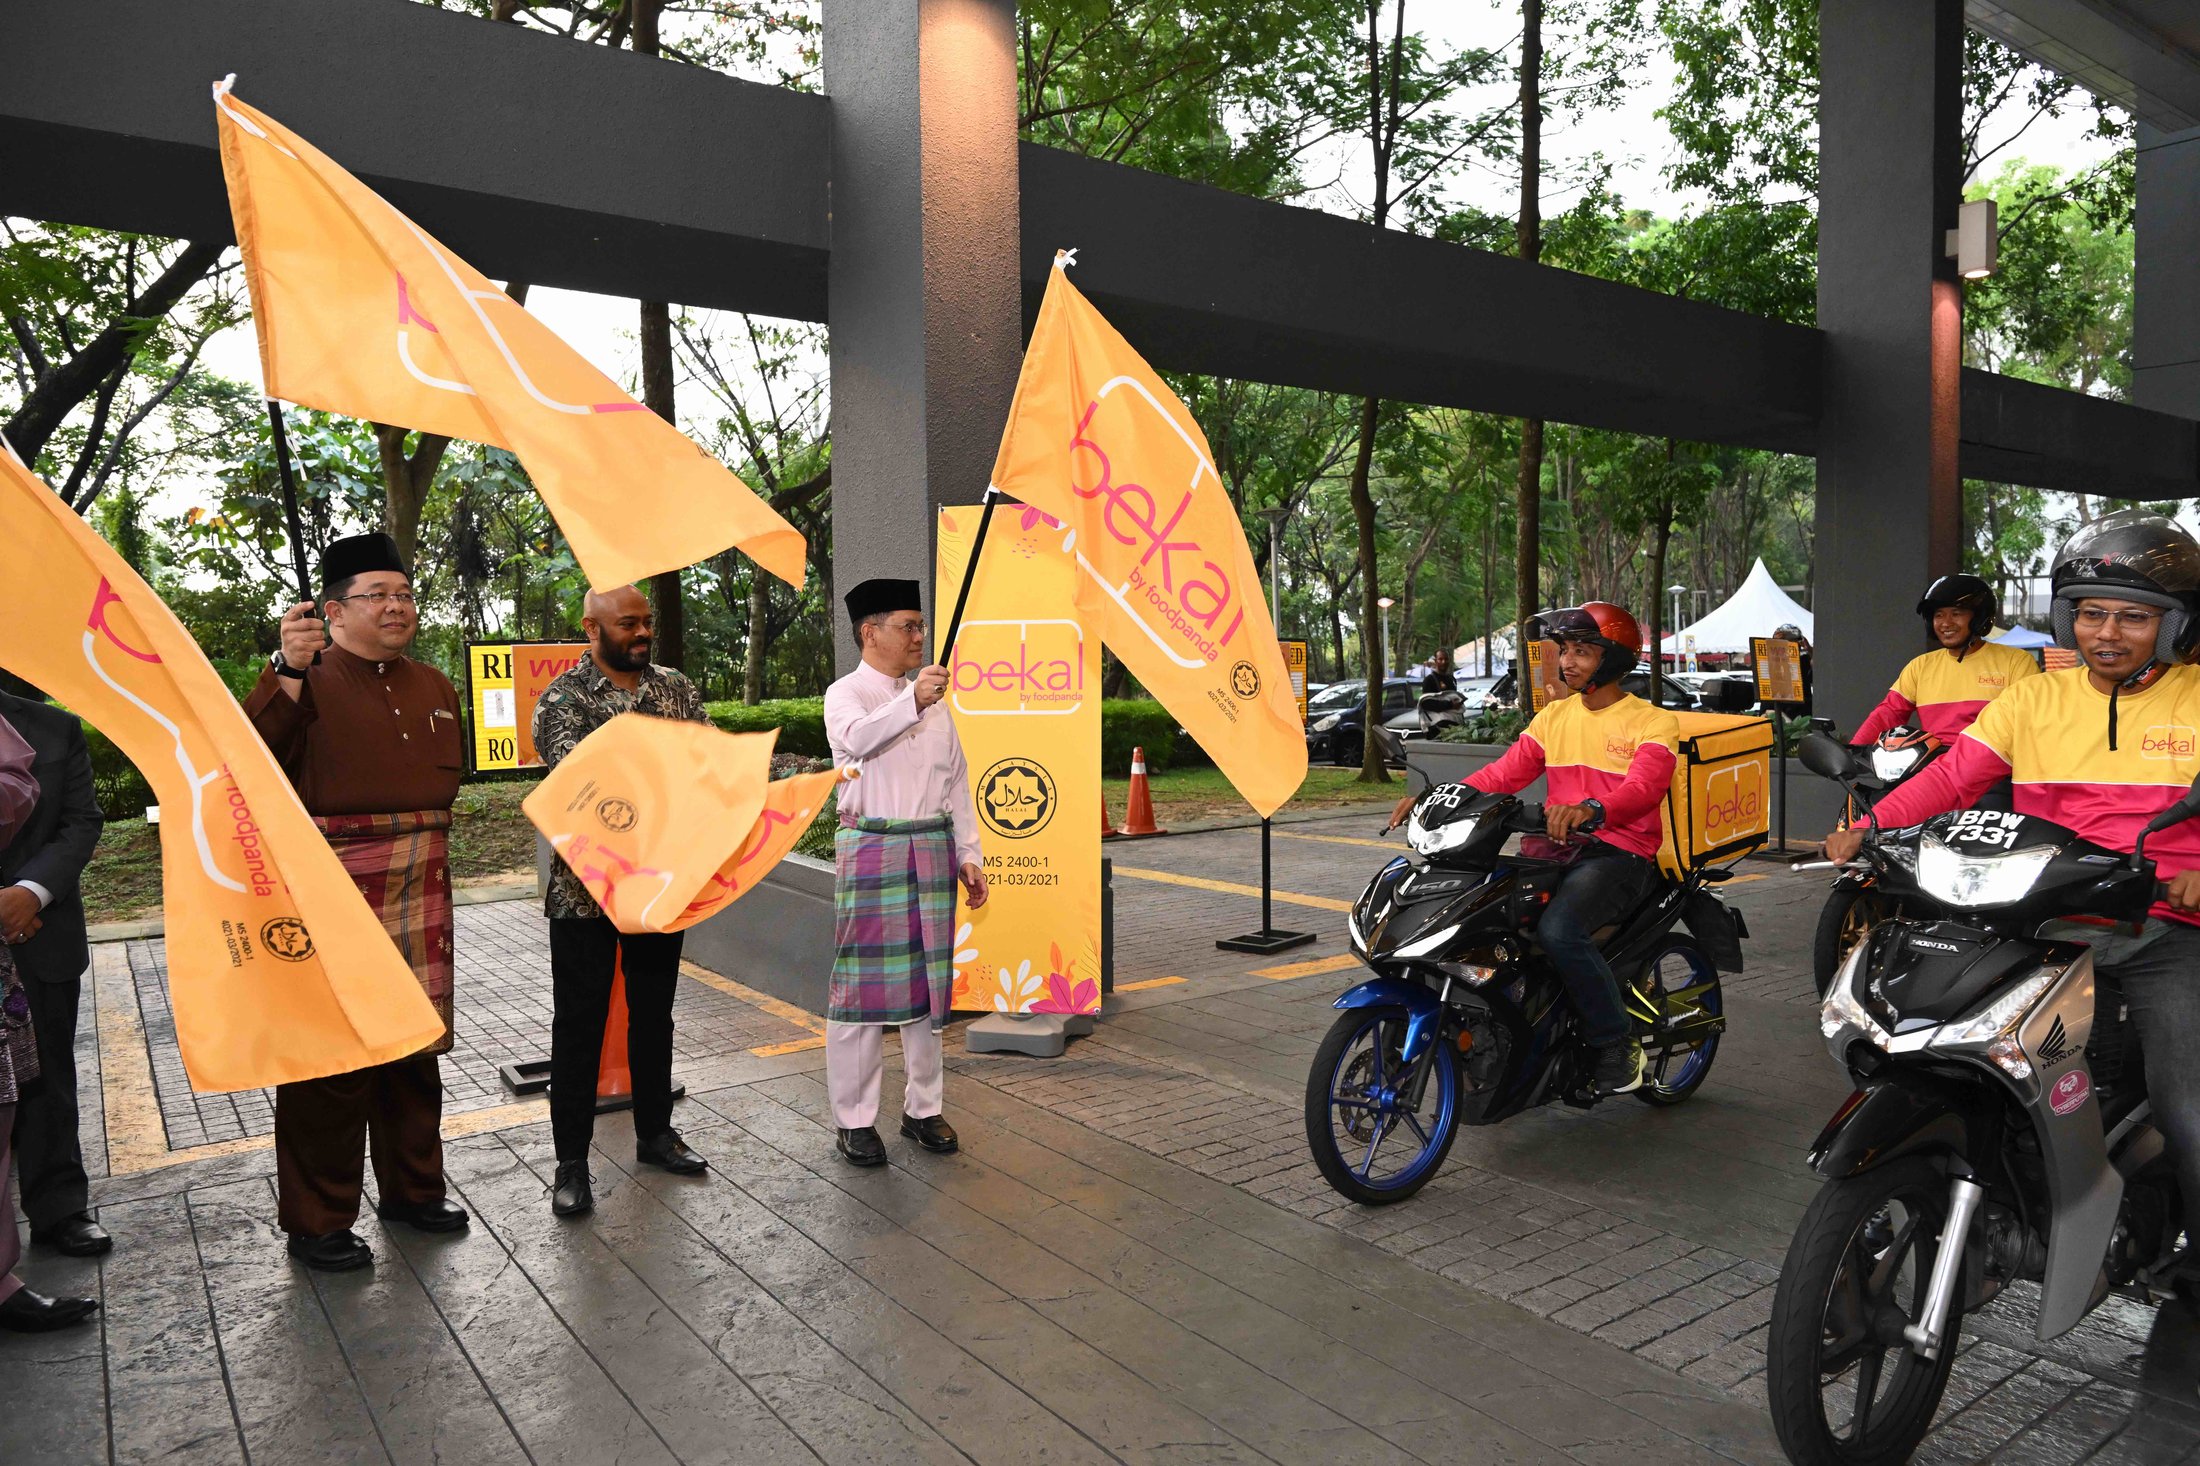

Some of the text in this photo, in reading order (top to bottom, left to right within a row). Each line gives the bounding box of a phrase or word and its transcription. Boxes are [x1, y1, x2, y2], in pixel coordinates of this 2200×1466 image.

[1070, 400, 1244, 647] bekal
[1129, 566, 1219, 662] by foodpanda
[952, 641, 1083, 692] bekal
[1020, 692, 1083, 703] by foodpanda
[1207, 690, 1237, 724] 4021-03/2021
[2141, 732, 2196, 753] bekal
[980, 761, 1052, 791] MALAYSIA
[994, 783, 1040, 807] حلال
[1432, 783, 1467, 796] SYT
[1705, 774, 1762, 830] bekal
[1957, 810, 2026, 830] BPW
[1944, 825, 2019, 849] 7331
[983, 856, 1049, 868] MS 2400-1
[1409, 879, 1462, 893] 150
[221, 919, 242, 968] 4021-03/2021
[1911, 939, 1960, 953] HONDA
[2041, 1044, 2083, 1071] HONDA
